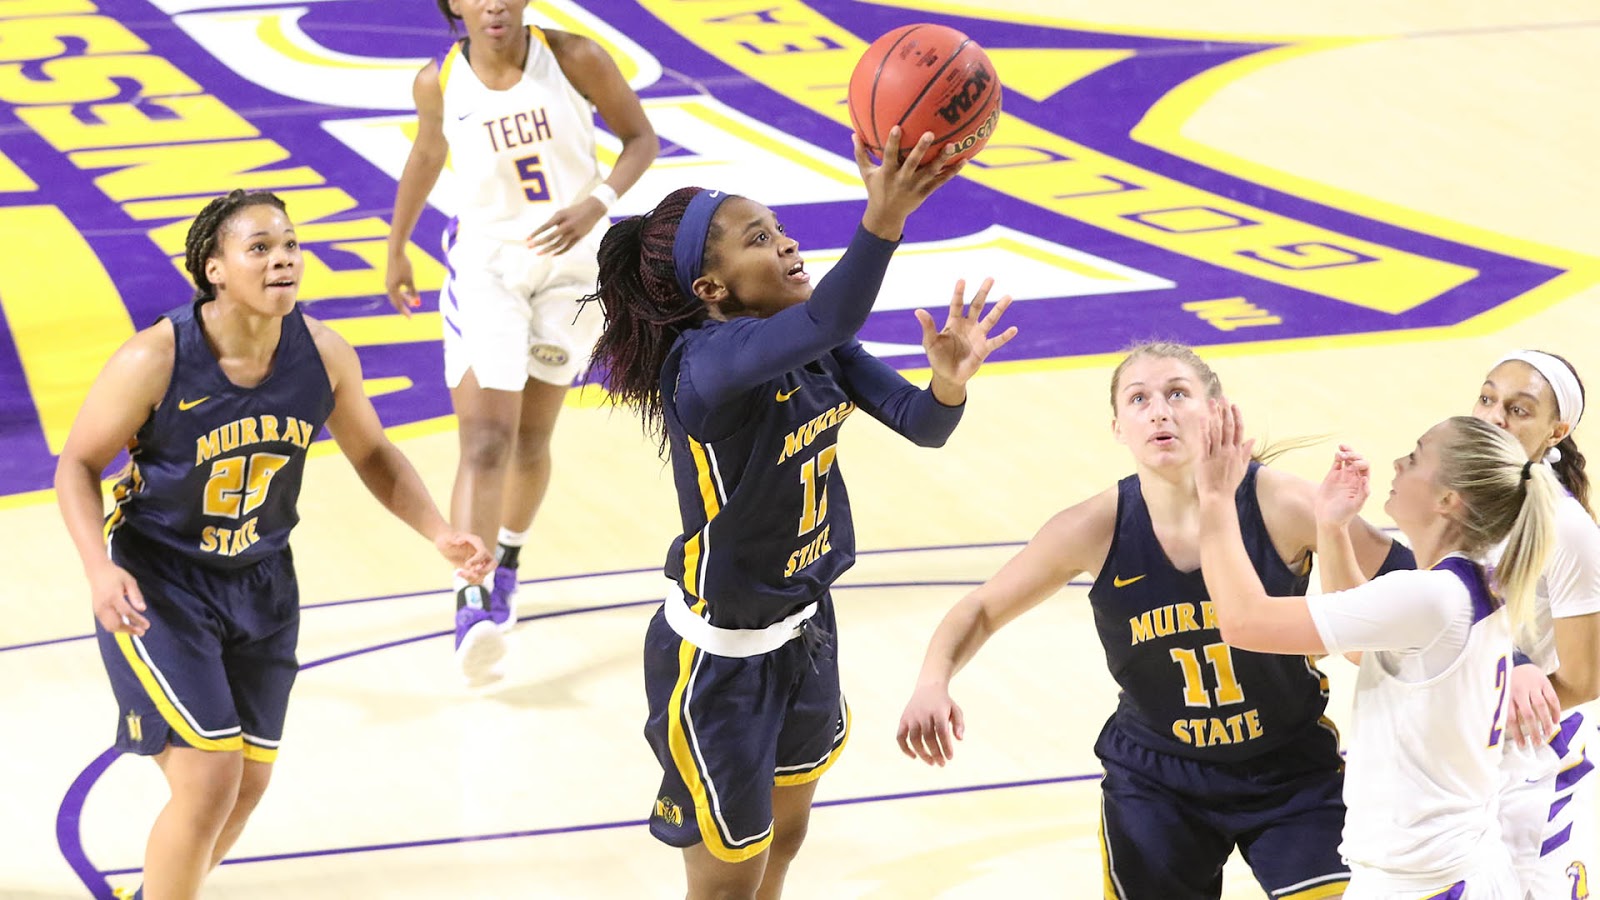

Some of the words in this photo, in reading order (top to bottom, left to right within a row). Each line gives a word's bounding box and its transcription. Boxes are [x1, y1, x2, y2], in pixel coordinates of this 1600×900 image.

[937, 61, 992, 125] NCAA
[483, 107, 551, 152] TECH
[513, 154, 552, 203] 5
[195, 414, 314, 467] MURRAY
[202, 452, 291, 519] 25
[200, 516, 260, 556] STATE
[784, 523, 832, 578] STATE
[1129, 600, 1221, 646] MURR
[1169, 641, 1246, 709] 11
[1172, 708, 1264, 748] STATE
